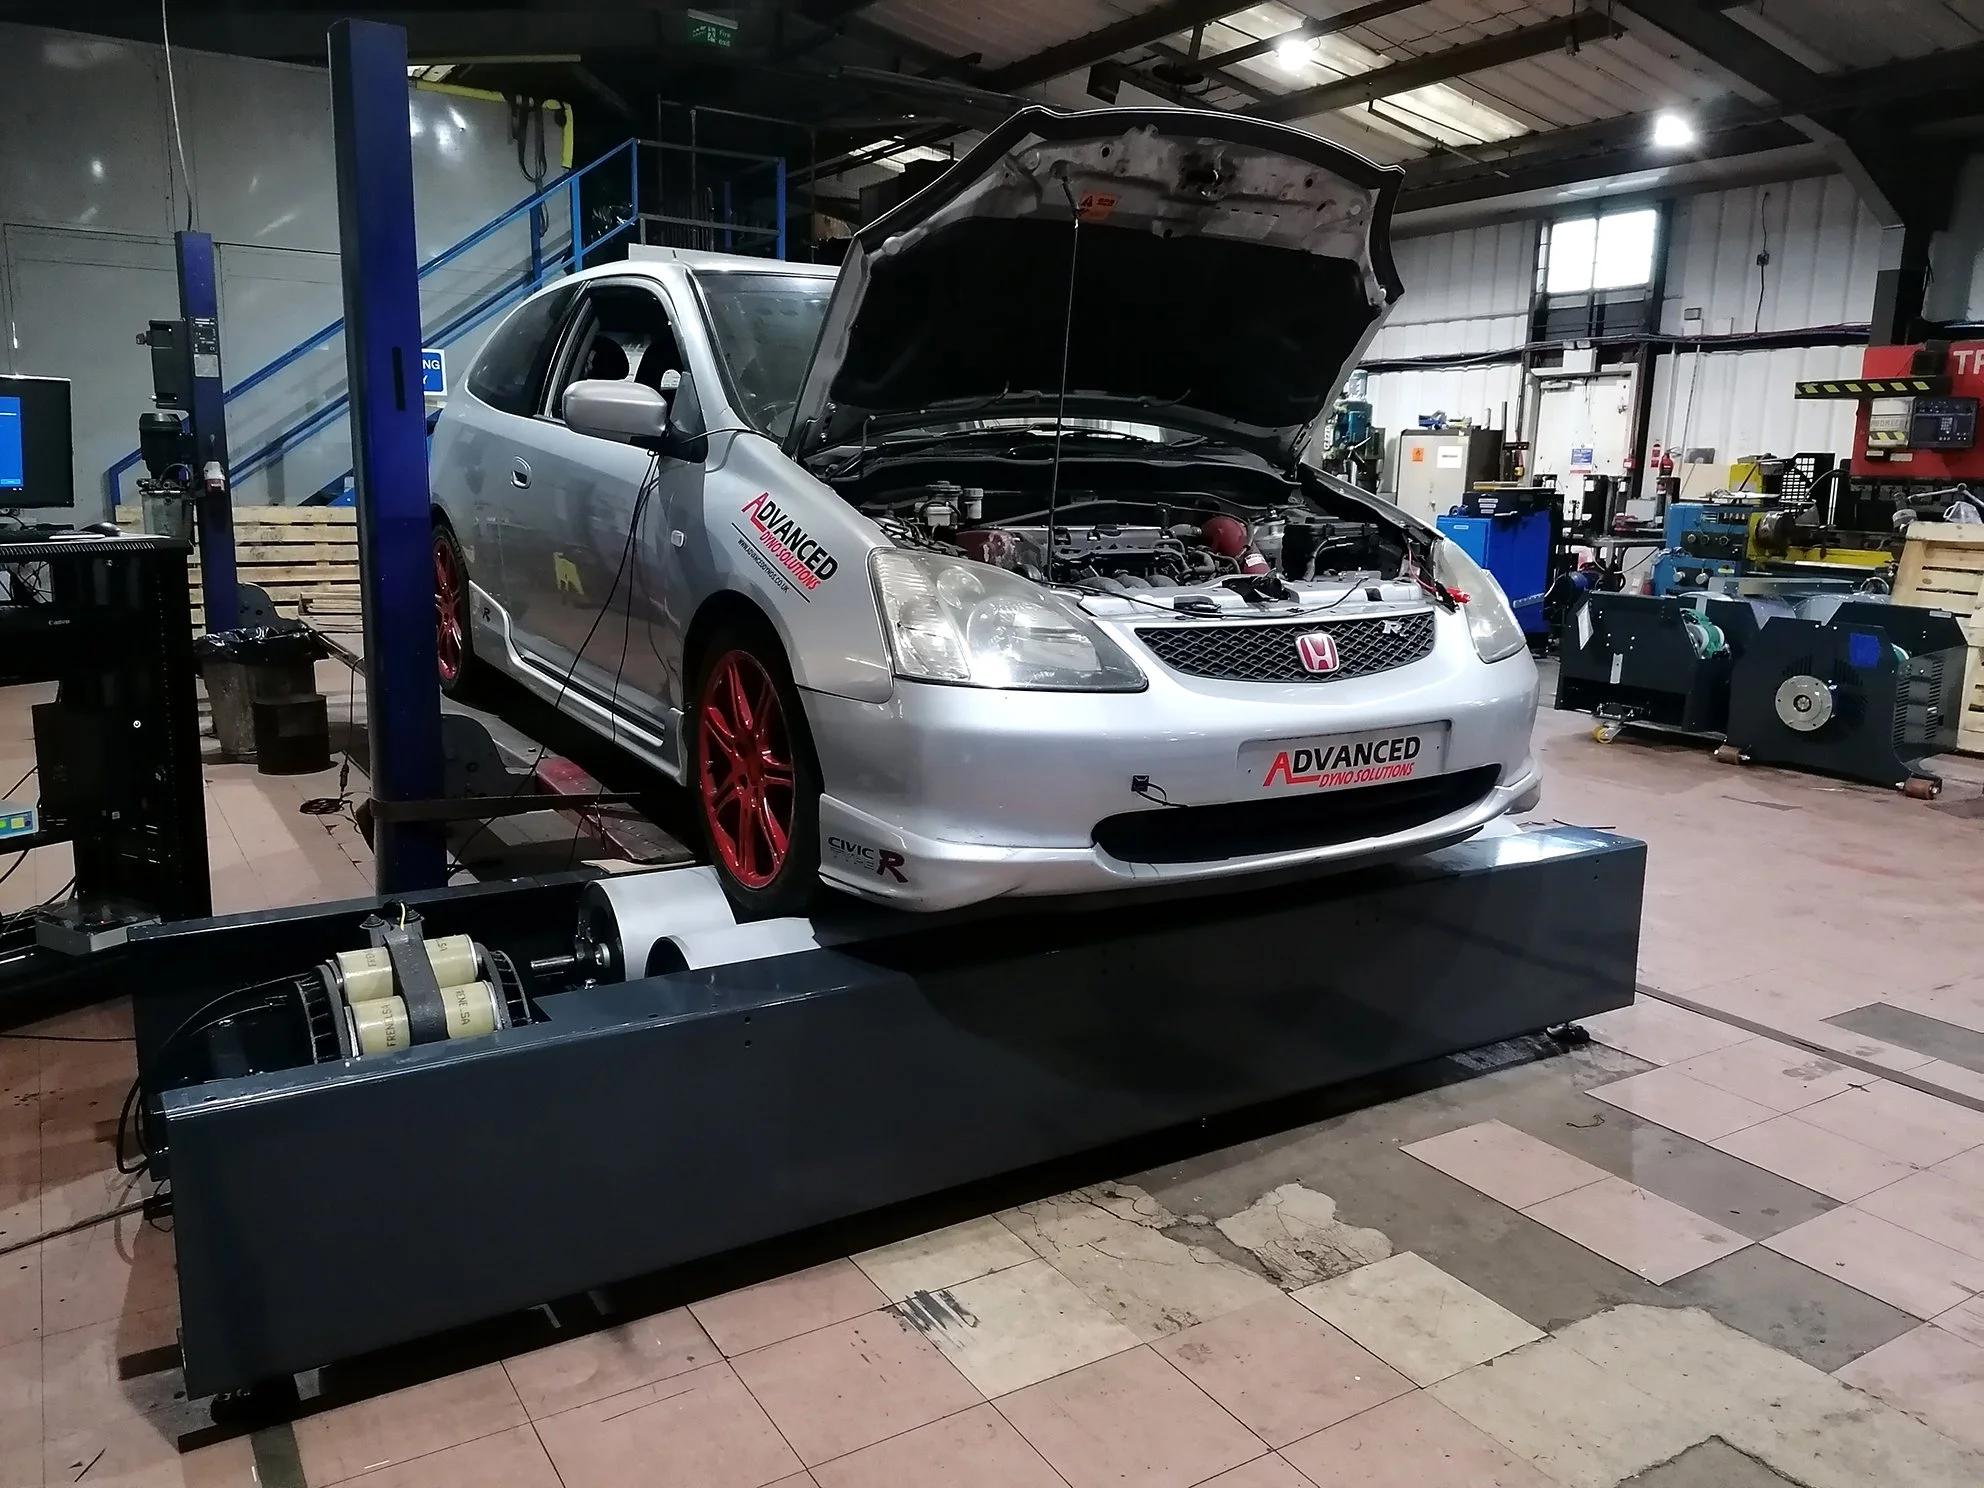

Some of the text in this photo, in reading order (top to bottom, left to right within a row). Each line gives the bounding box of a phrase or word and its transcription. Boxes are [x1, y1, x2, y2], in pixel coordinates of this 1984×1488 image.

[741, 492, 839, 581] ADVANCED
[759, 530, 821, 590] DYNO SOLUTIONS
[1263, 736, 1421, 787] ADVANCED
[1318, 762, 1415, 787] DYNO SOLUTIONS
[827, 836, 874, 860] CIVIC
[876, 848, 909, 883] R
